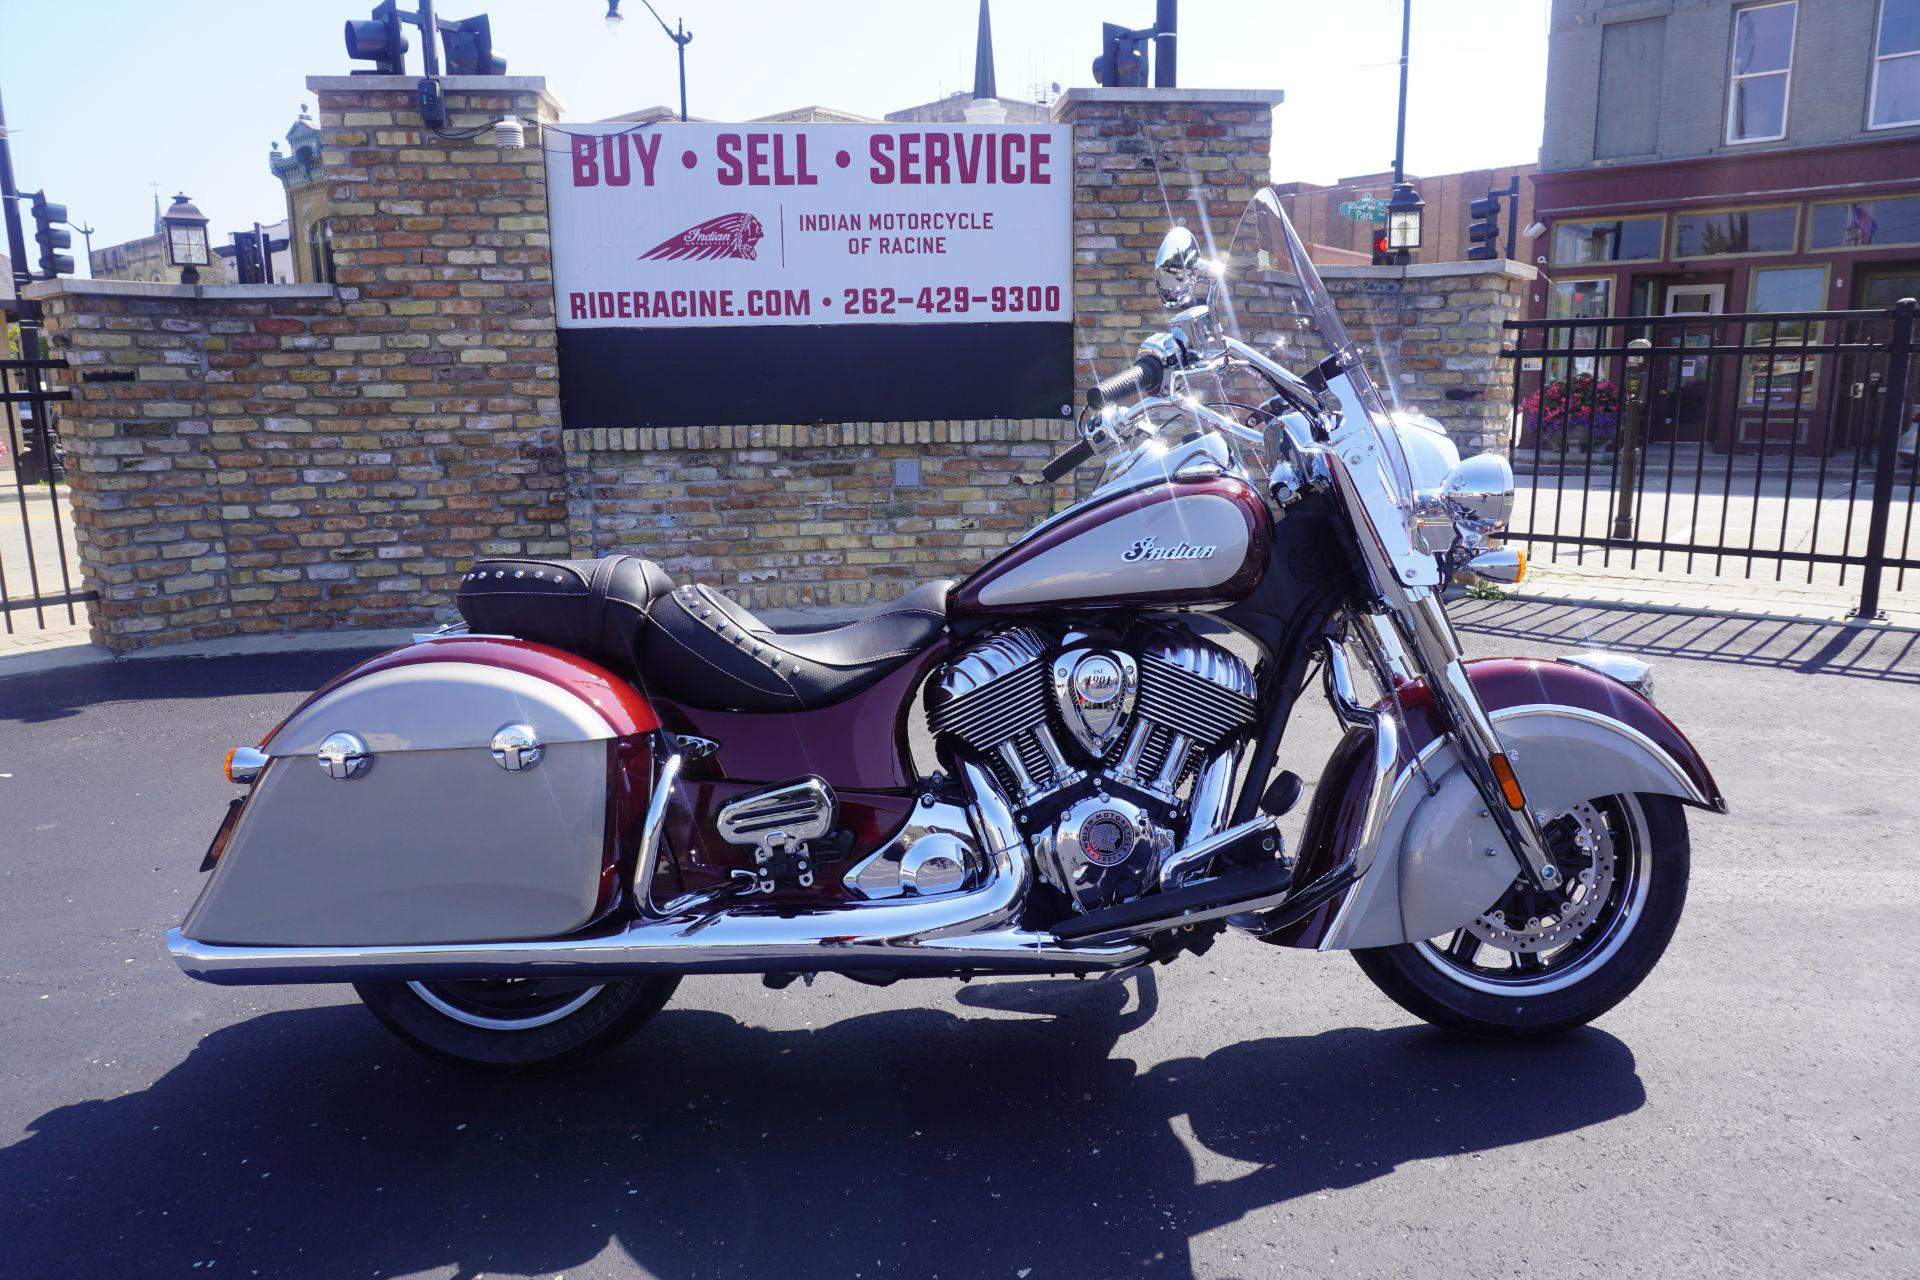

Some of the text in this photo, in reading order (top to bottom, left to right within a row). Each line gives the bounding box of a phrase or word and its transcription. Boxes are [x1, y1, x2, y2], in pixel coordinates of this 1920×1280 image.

[572, 133, 1052, 187] BUY SELL SERVICE
[799, 212, 994, 232] INDIAN MOTORCYCLE
[1356, 209, 1374, 220] Park
[683, 228, 731, 242] Indian
[848, 236, 946, 255] OF RACINE
[570, 285, 1061, 320] RIDERACINE.COM 262-429-9300
[1121, 535, 1217, 562] Indian
[1087, 675, 1111, 686] 1901
[1083, 812, 1132, 853] INDIAN MOTORCYCLE
